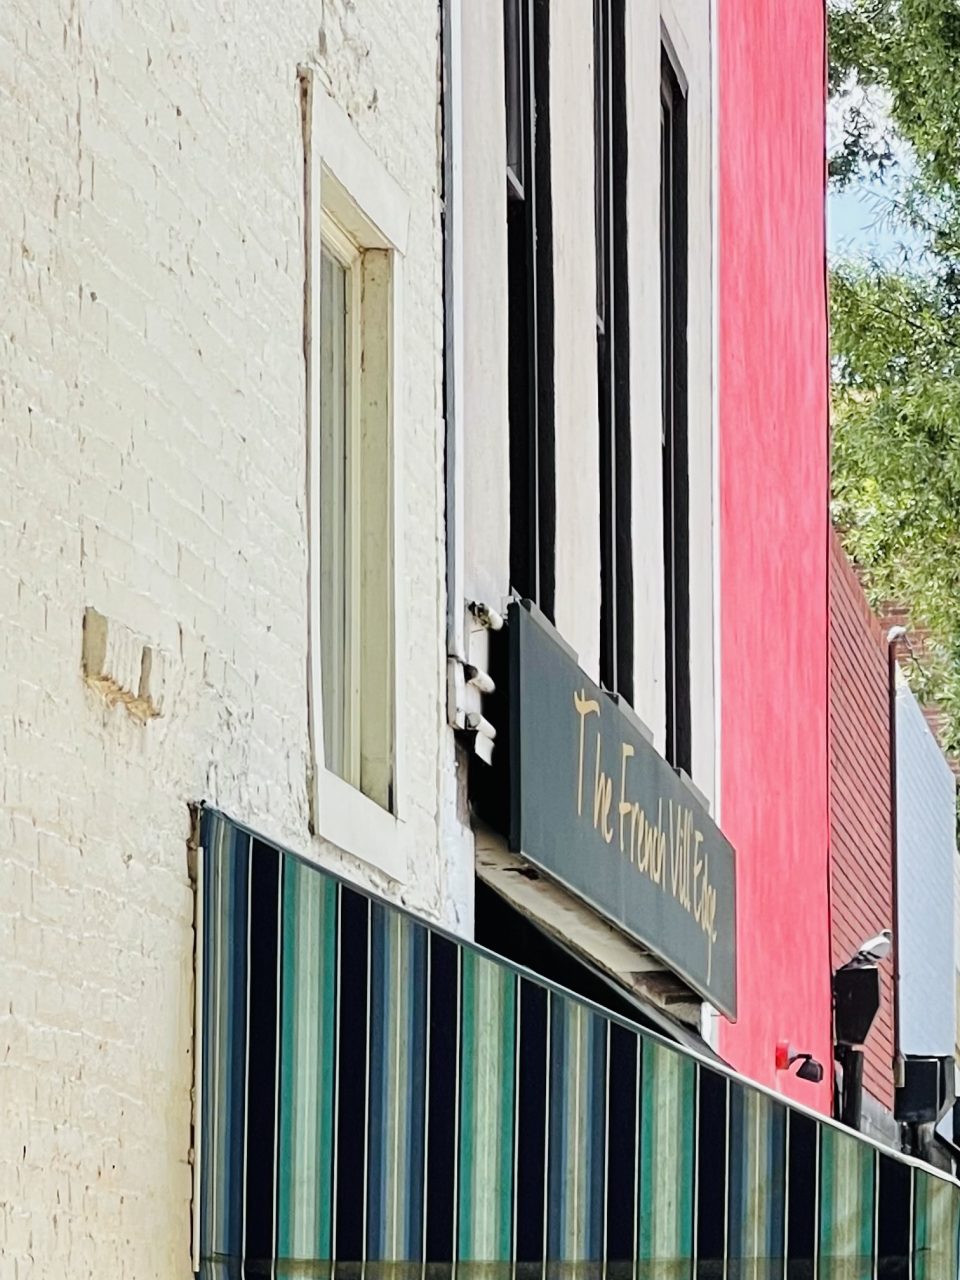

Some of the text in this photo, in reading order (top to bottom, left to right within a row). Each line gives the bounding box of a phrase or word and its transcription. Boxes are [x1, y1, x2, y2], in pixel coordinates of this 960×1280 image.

[574, 688, 613, 844] The
[619, 742, 667, 893] French
[668, 799, 693, 913] Vill
